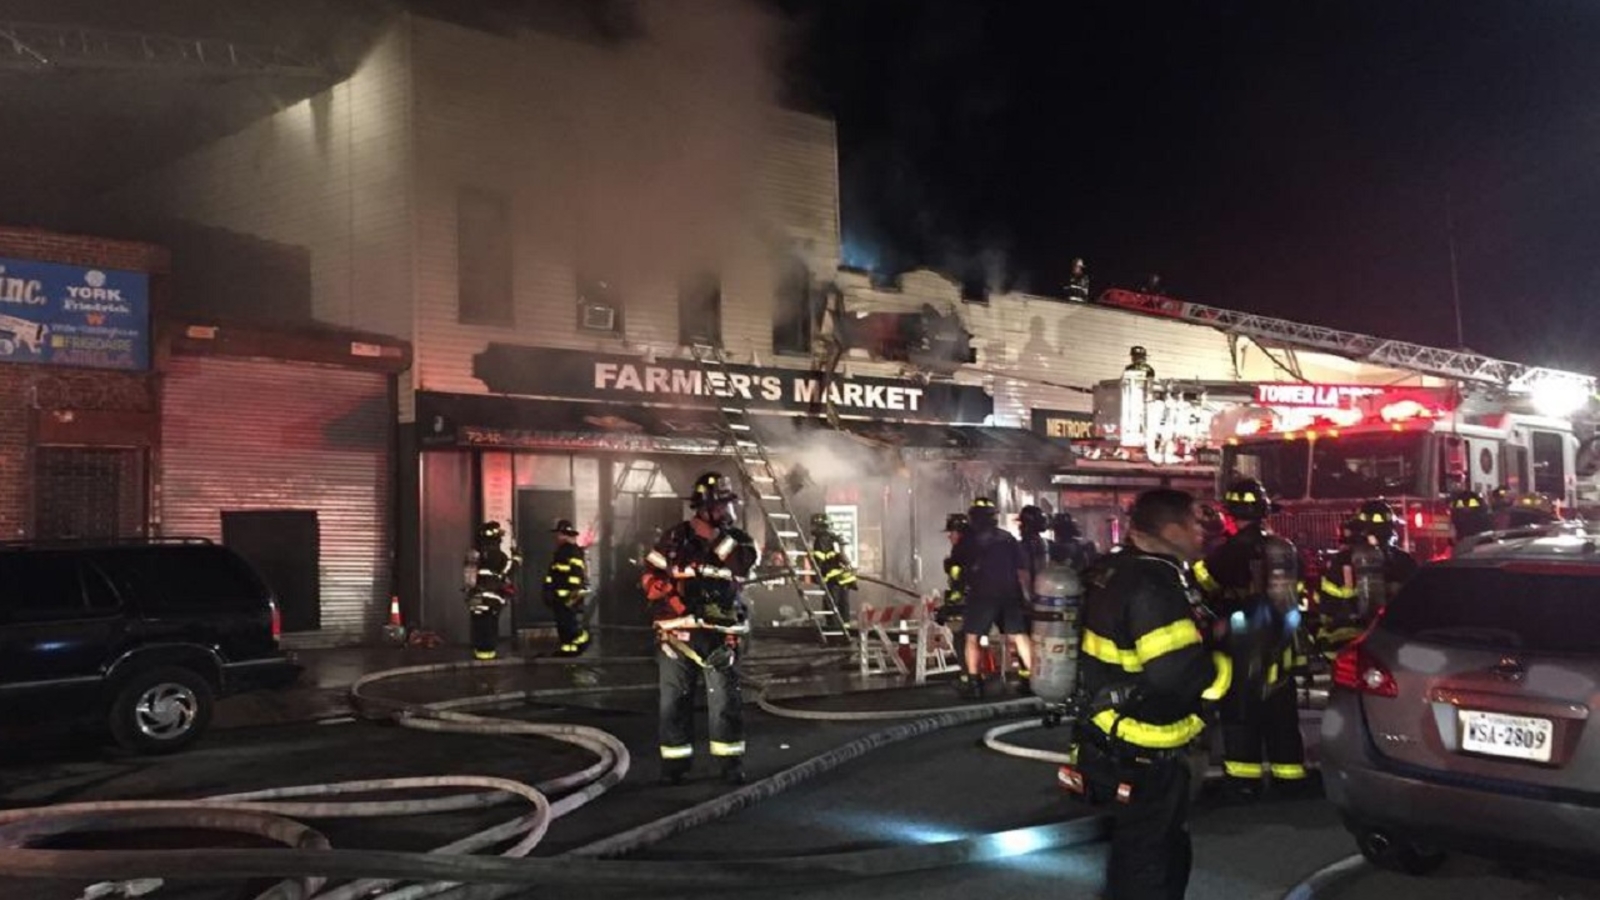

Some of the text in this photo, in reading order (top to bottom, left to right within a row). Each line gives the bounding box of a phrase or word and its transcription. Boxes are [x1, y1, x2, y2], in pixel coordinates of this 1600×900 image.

[66, 286, 121, 301] YORK
[594, 362, 923, 411] FARMER'S MARKET
[1258, 384, 1314, 404] TOWER
[1469, 723, 1546, 749] WSA-2809
